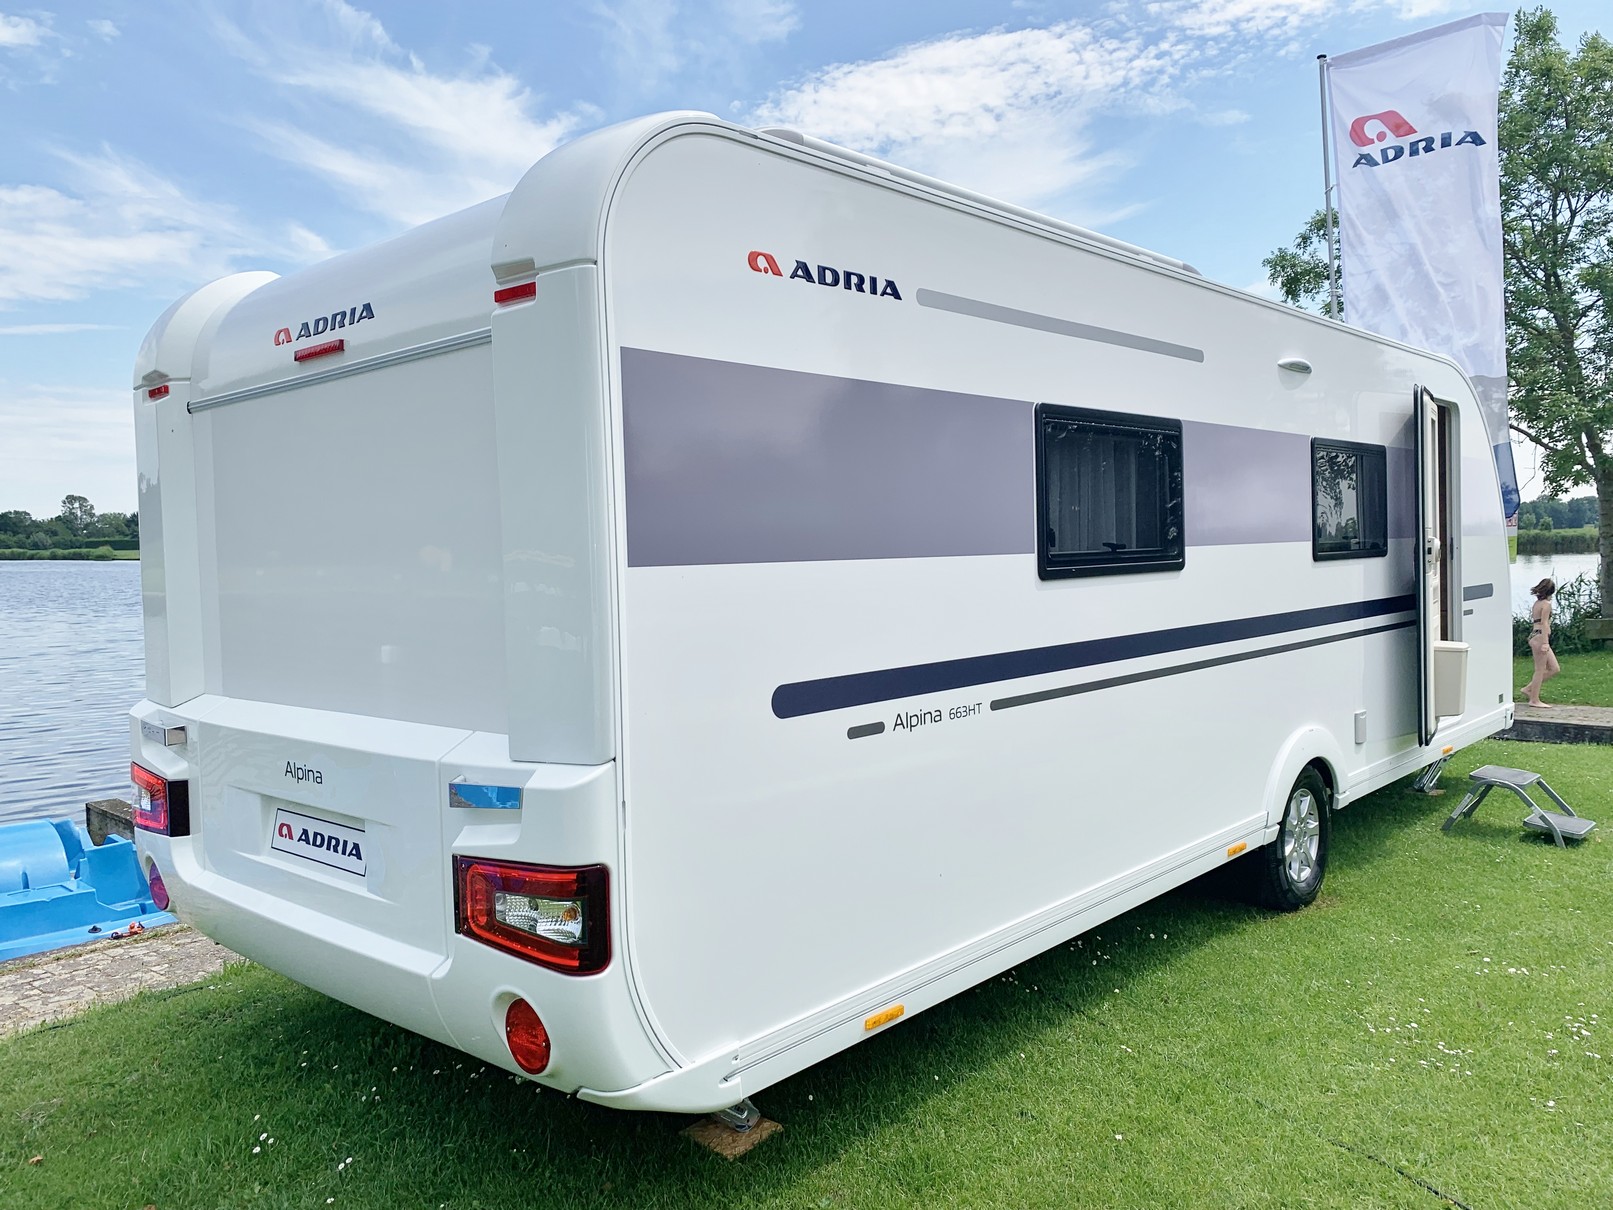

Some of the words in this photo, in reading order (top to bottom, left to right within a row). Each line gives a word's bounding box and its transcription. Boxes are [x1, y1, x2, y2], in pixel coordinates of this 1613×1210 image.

[1352, 131, 1487, 168] ADRIA
[789, 259, 903, 301] ADRIA
[295, 302, 375, 341] ADRIA
[893, 709, 942, 732] Alpina
[948, 702, 983, 720] 663HT
[284, 760, 323, 784] Alpina
[297, 828, 363, 861] ADRIA
